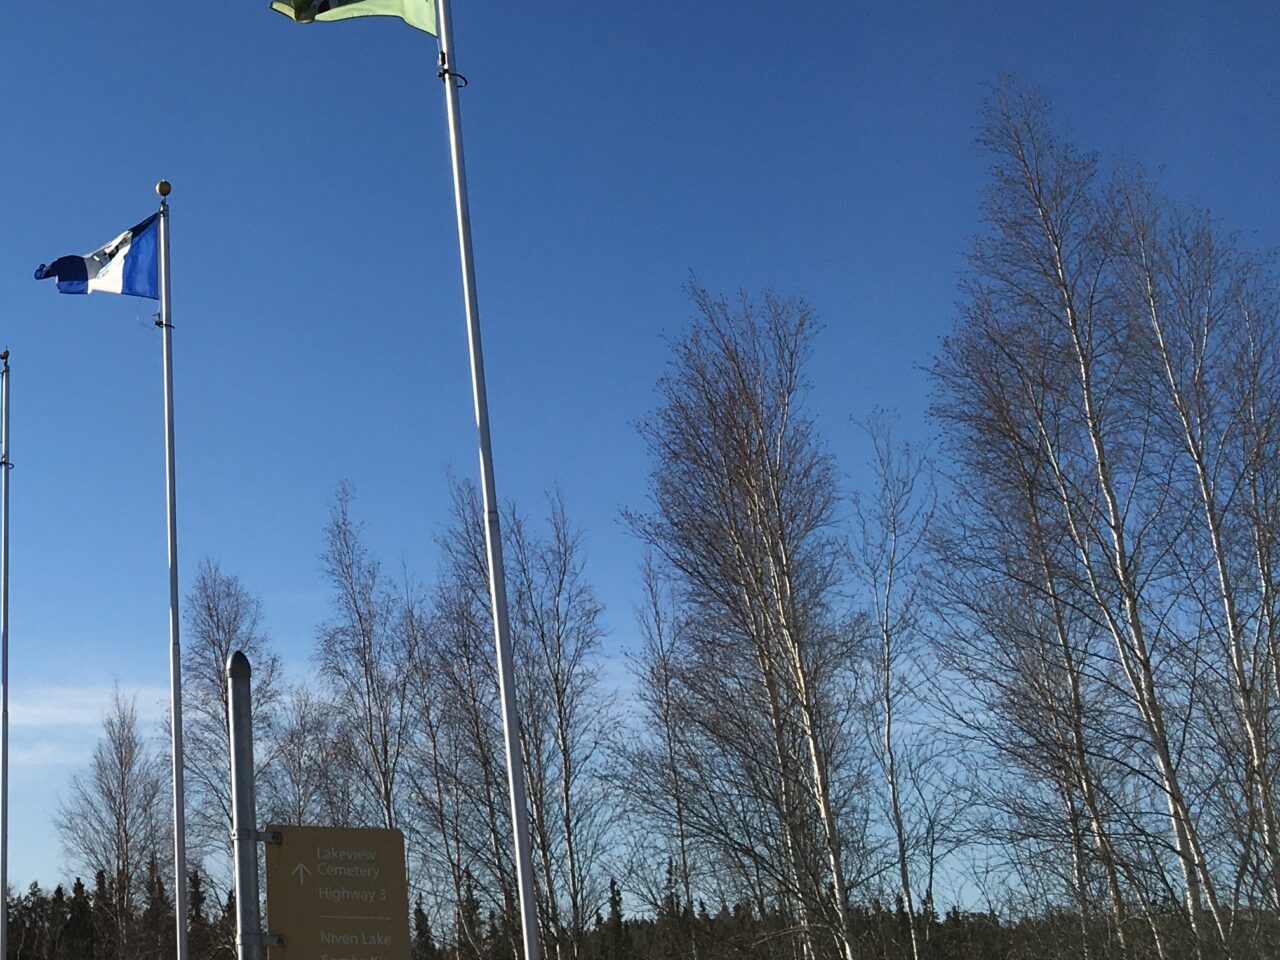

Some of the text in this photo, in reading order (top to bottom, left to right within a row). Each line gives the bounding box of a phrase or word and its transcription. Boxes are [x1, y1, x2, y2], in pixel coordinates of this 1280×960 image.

[317, 847, 377, 862] Lakeview
[316, 863, 380, 880] Cemetery
[319, 887, 387, 903] Highway 3
[320, 931, 392, 946] Niven Lake
